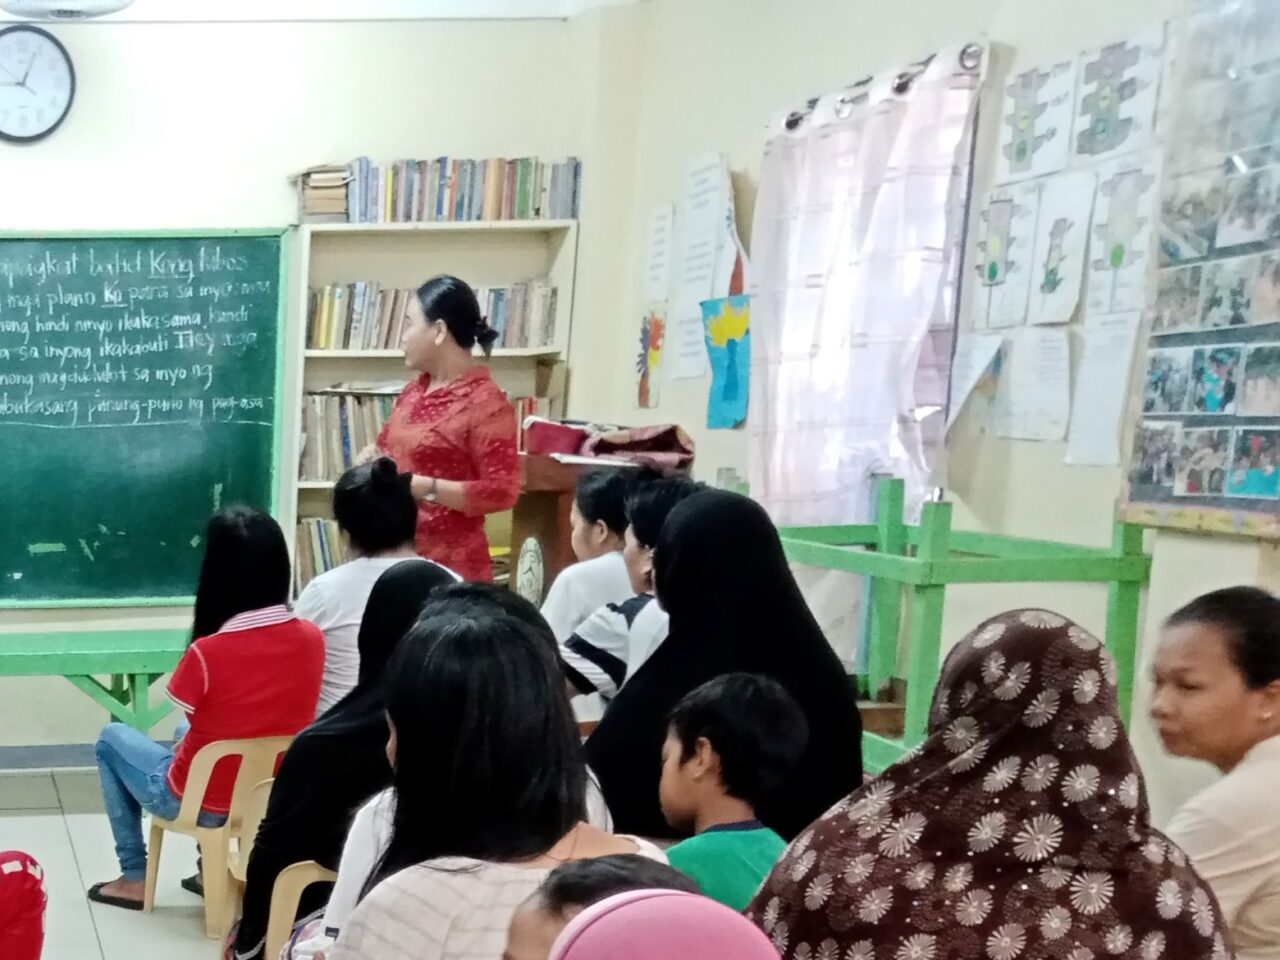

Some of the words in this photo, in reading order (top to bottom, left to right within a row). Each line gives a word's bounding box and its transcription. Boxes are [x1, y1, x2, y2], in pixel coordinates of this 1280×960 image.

[47, 283, 96, 316] plano
[128, 286, 169, 309] para
[176, 284, 193, 299] sa
[35, 312, 70, 333] hindi
[75, 319, 113, 342] ninyo
[19, 345, 39, 361] sa
[44, 340, 91, 369] inyong
[133, 366, 150, 382] sa
[192, 364, 213, 391] ng
[188, 397, 203, 418] ng
